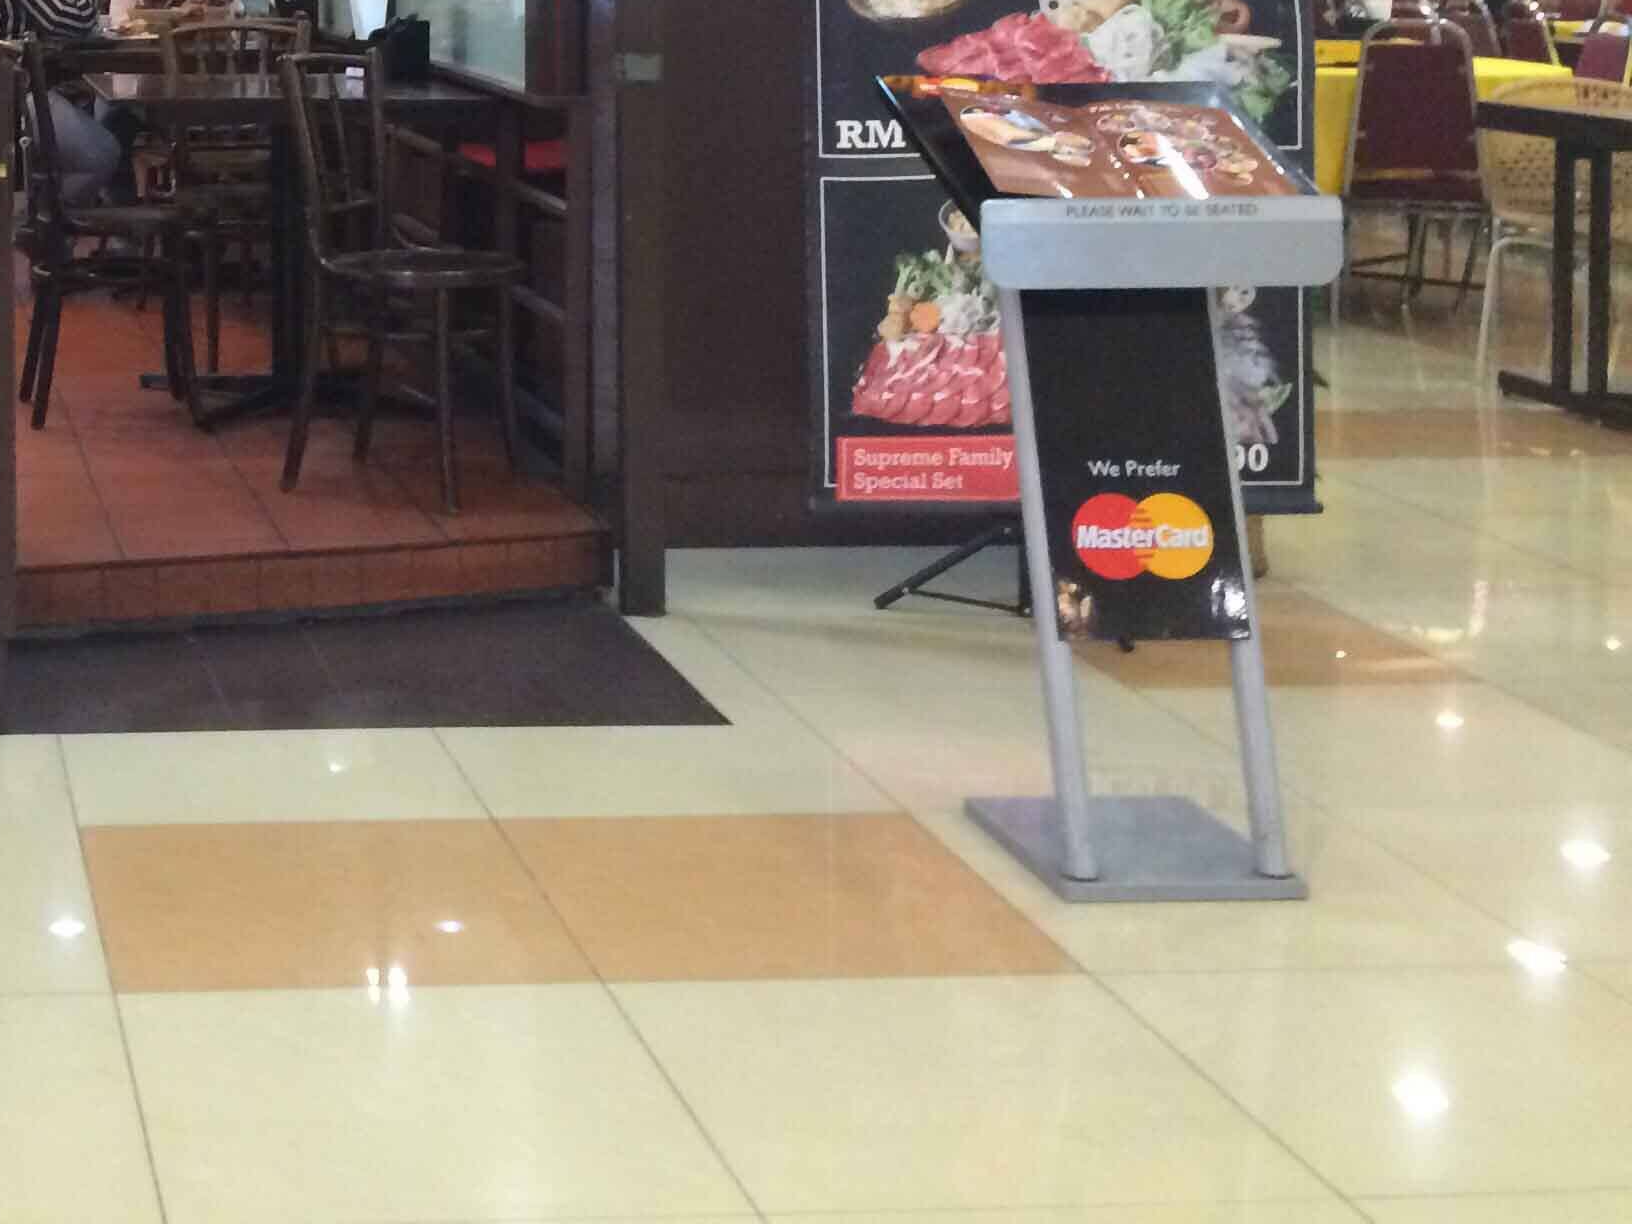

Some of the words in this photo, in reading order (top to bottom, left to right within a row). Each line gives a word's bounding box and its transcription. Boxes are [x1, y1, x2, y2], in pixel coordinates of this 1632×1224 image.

[835, 118, 907, 151] RM
[1120, 205, 1154, 217] WAIT
[853, 448, 944, 471] Supreme
[949, 447, 1014, 469] Family
[1087, 460, 1120, 477] We
[1125, 459, 1181, 477] Prefer
[853, 472, 928, 494] Special
[932, 472, 964, 490] Set
[1077, 524, 1210, 549] MasterCard
